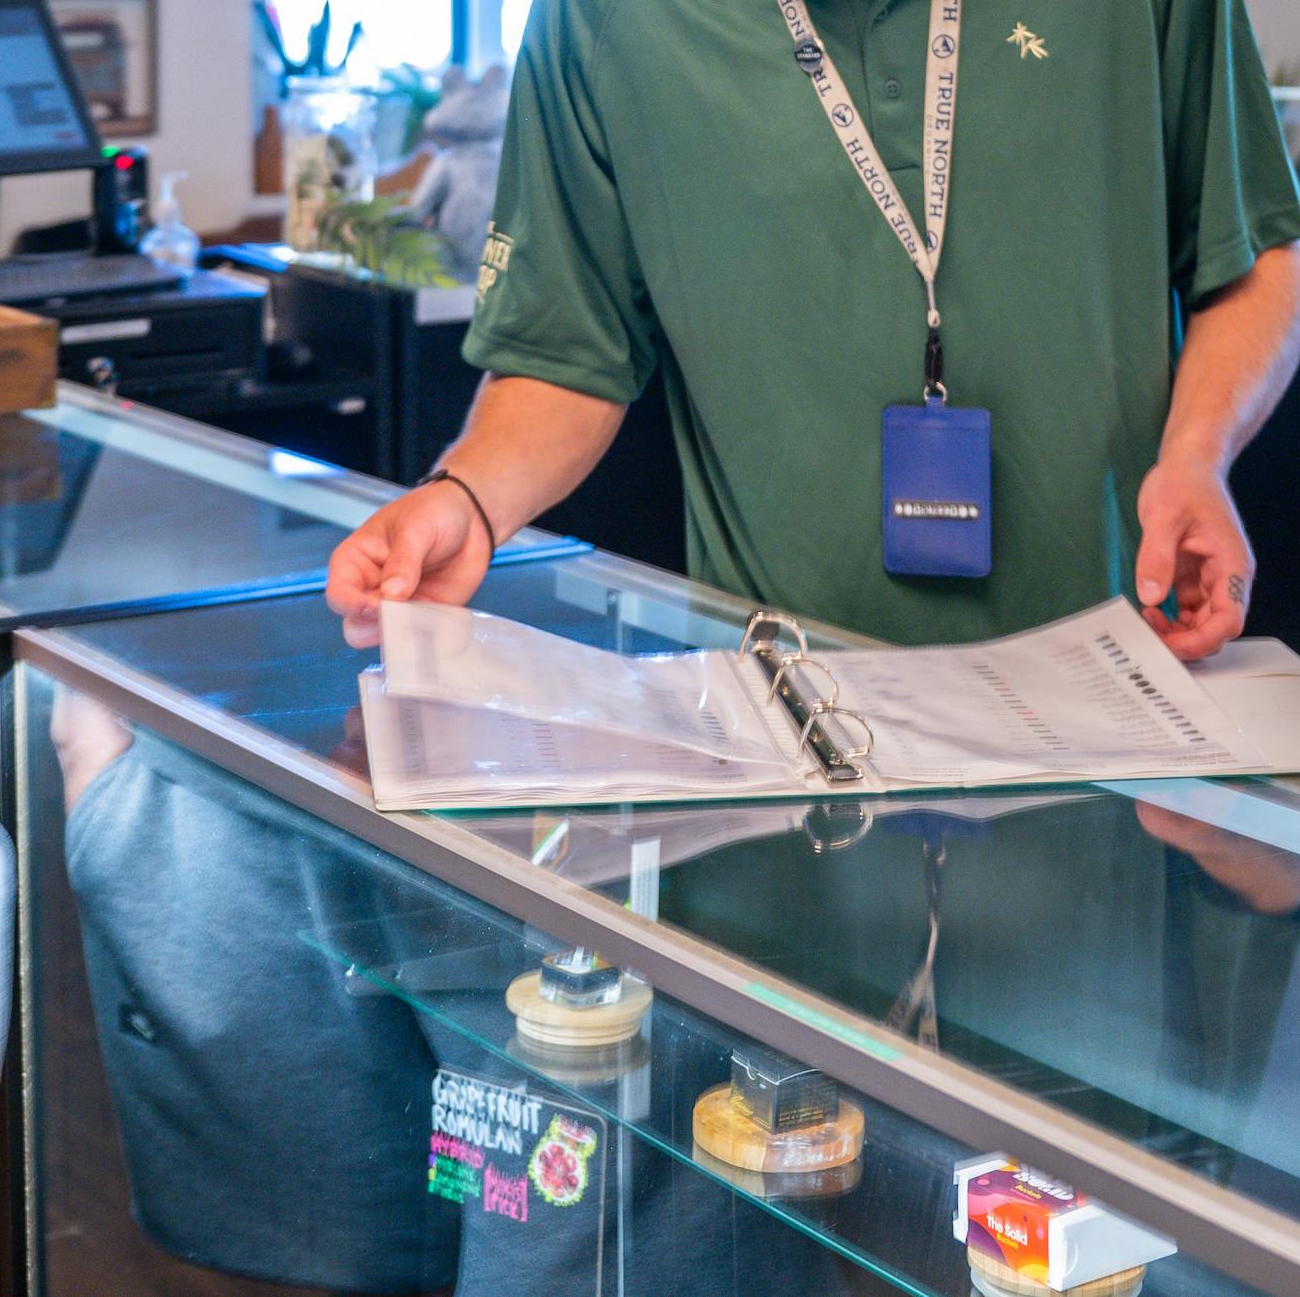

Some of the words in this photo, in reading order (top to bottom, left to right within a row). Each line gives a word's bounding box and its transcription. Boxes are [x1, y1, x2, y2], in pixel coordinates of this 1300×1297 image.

[935, 72, 954, 130] TRUE
[846, 138, 895, 210] NORTH
[929, 138, 948, 219] NORTH
[891, 213, 919, 264] RUE
[431, 1076, 542, 1135] GRAPEFRUIT
[431, 1104, 524, 1156] ROMULAN
[986, 1214, 1004, 1234] The
[1004, 1221, 1028, 1247] Solid
